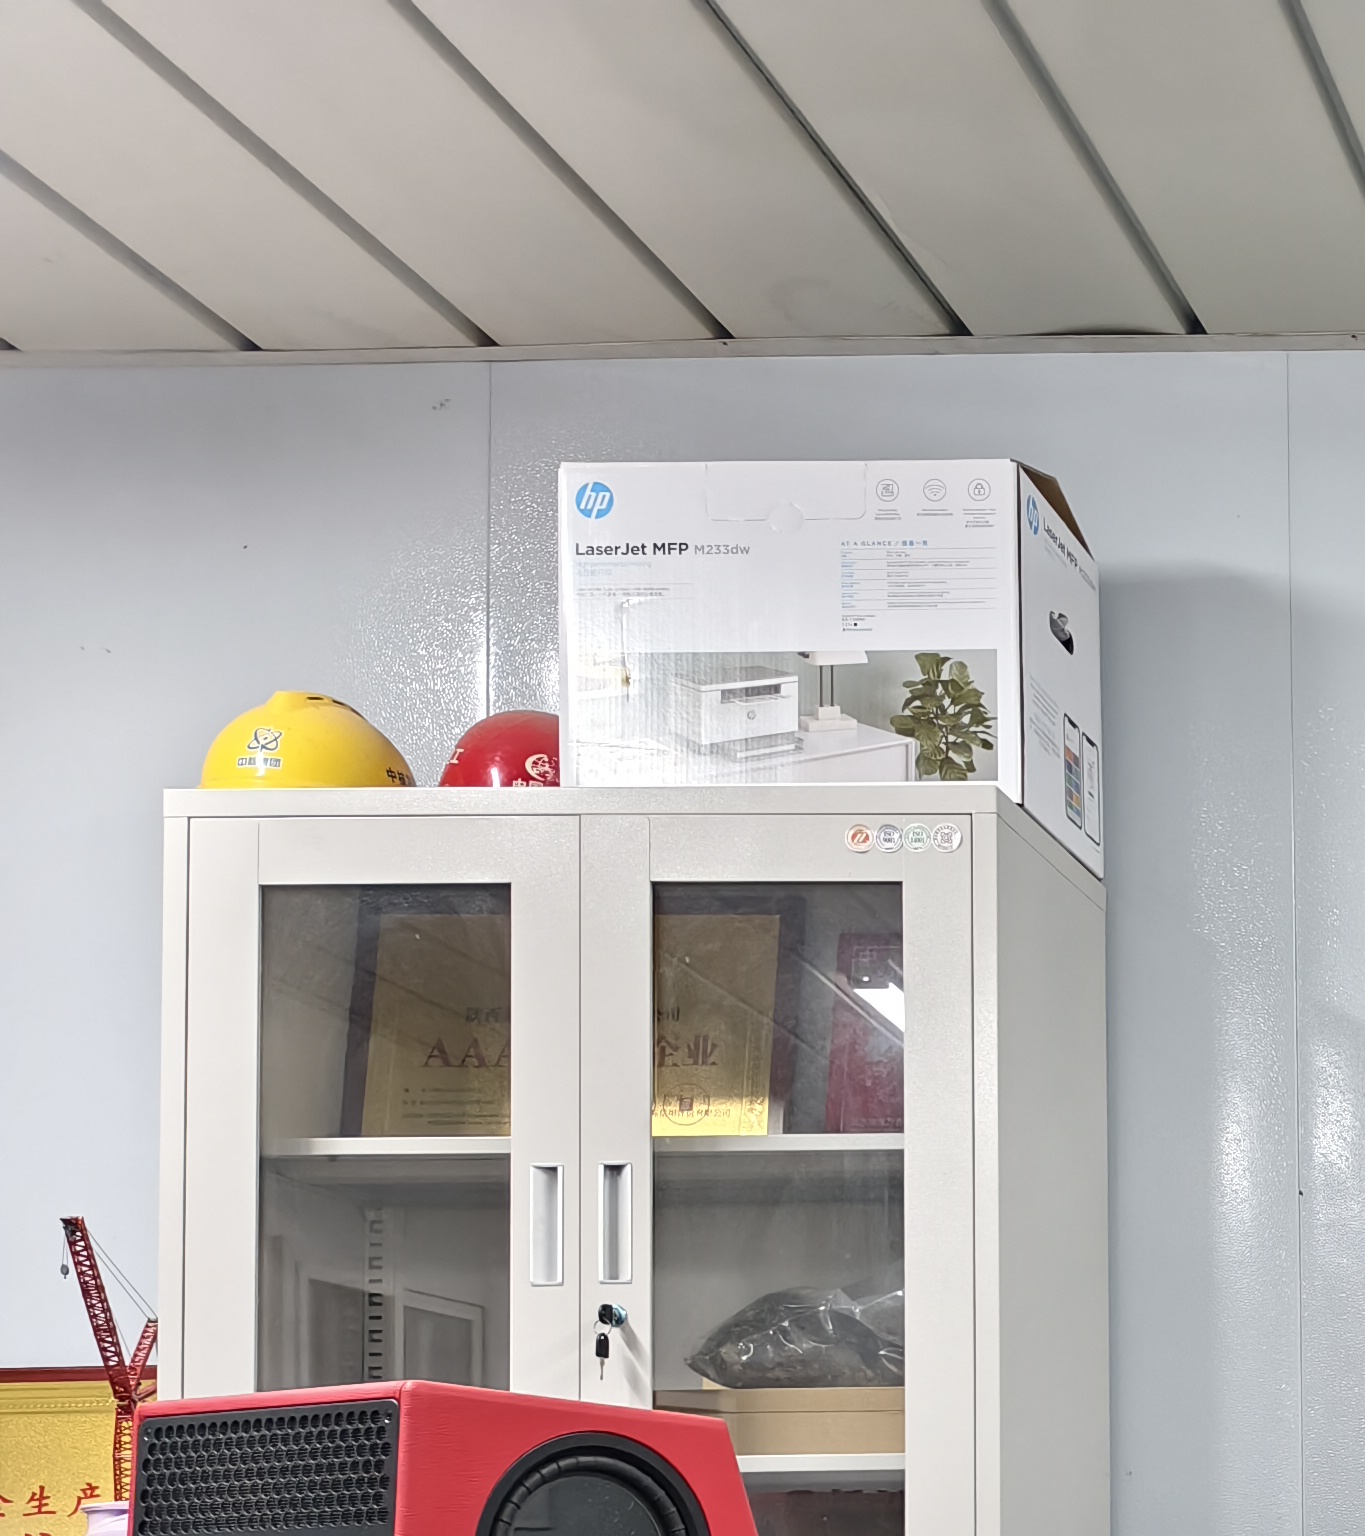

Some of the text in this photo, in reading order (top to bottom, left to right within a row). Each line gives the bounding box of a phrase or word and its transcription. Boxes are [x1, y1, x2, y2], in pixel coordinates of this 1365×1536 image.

[577, 481, 612, 519] hp
[575, 542, 751, 556] LaserJet MFP M233dw
